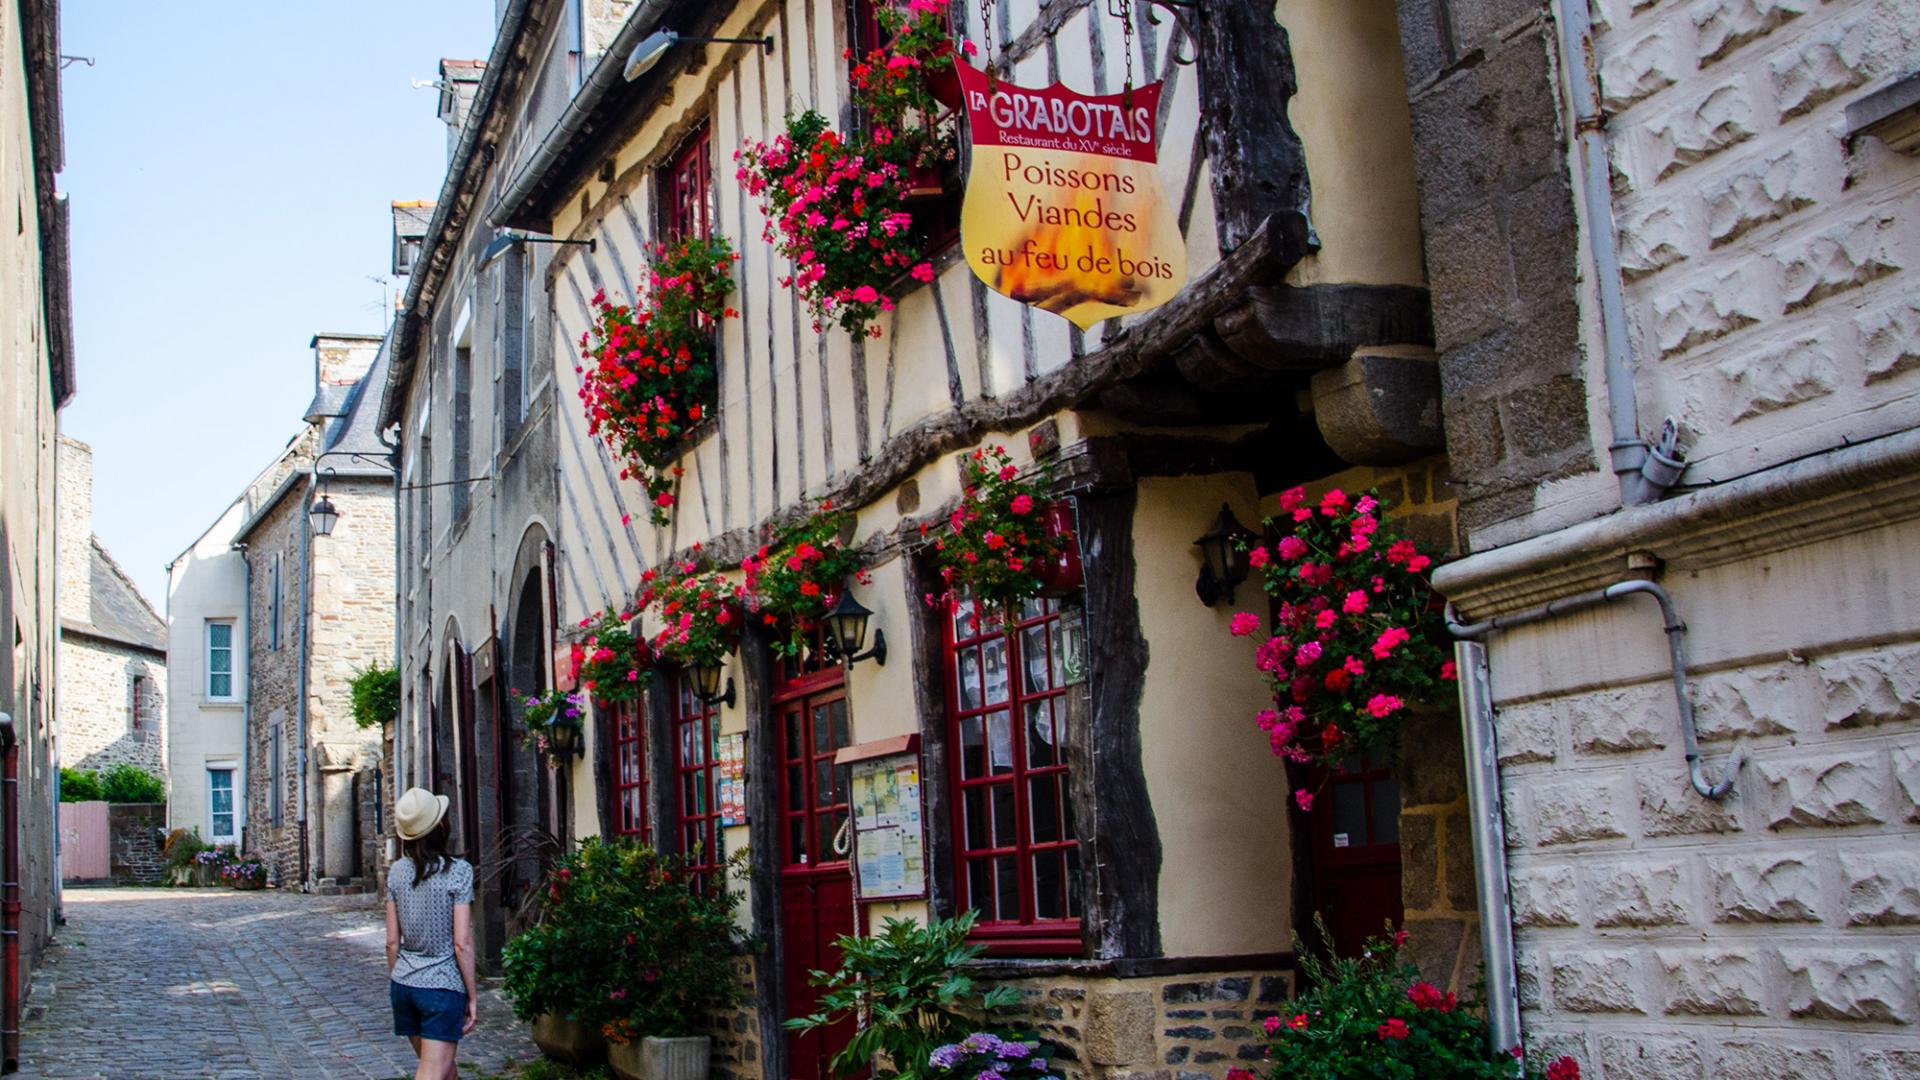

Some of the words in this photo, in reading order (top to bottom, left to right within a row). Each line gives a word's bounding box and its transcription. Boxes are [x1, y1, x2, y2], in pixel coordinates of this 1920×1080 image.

[970, 90, 988, 112] LA
[990, 91, 1151, 143] GRABOTAIS
[999, 130, 1061, 150] Restaurant
[1062, 137, 1078, 150] du
[1102, 143, 1132, 156] siècle
[1003, 152, 1135, 194] Poissons
[1007, 192, 1137, 232] Viandes
[981, 246, 1014, 266] au
[1022, 239, 1068, 271] feu
[1076, 246, 1112, 274] de
[1117, 248, 1173, 280] bois
